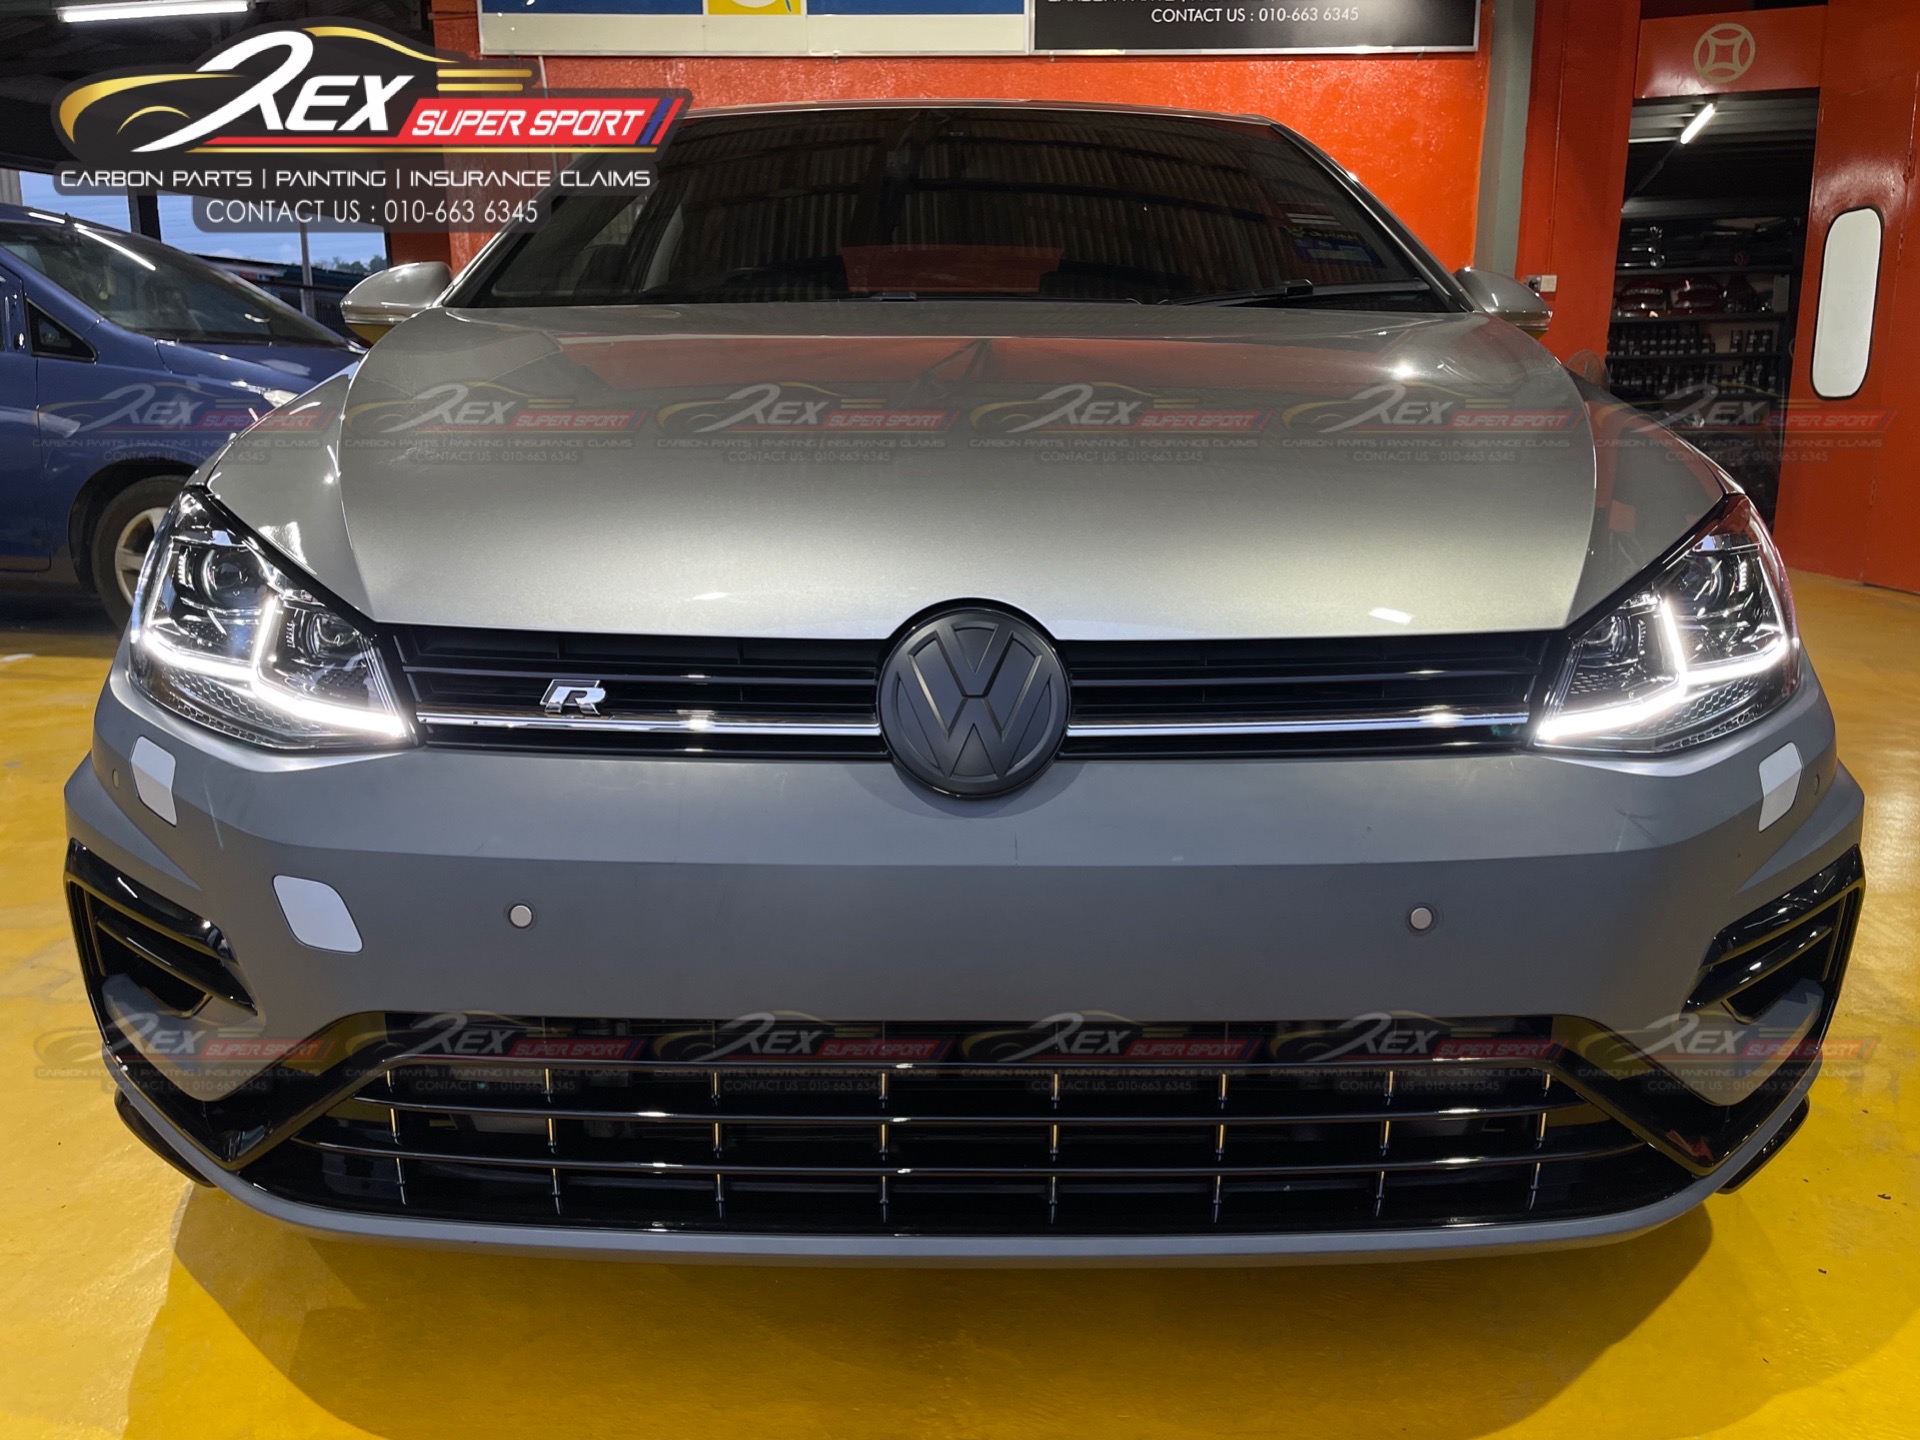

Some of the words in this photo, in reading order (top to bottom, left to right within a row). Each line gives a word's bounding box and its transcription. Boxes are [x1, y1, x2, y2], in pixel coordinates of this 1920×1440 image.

[1151, 8, 1223, 23] CONTACT
[1226, 8, 1246, 22] US
[1258, 7, 1319, 22] 010-663
[1322, 6, 1360, 21] 6345
[544, 685, 607, 716] R
